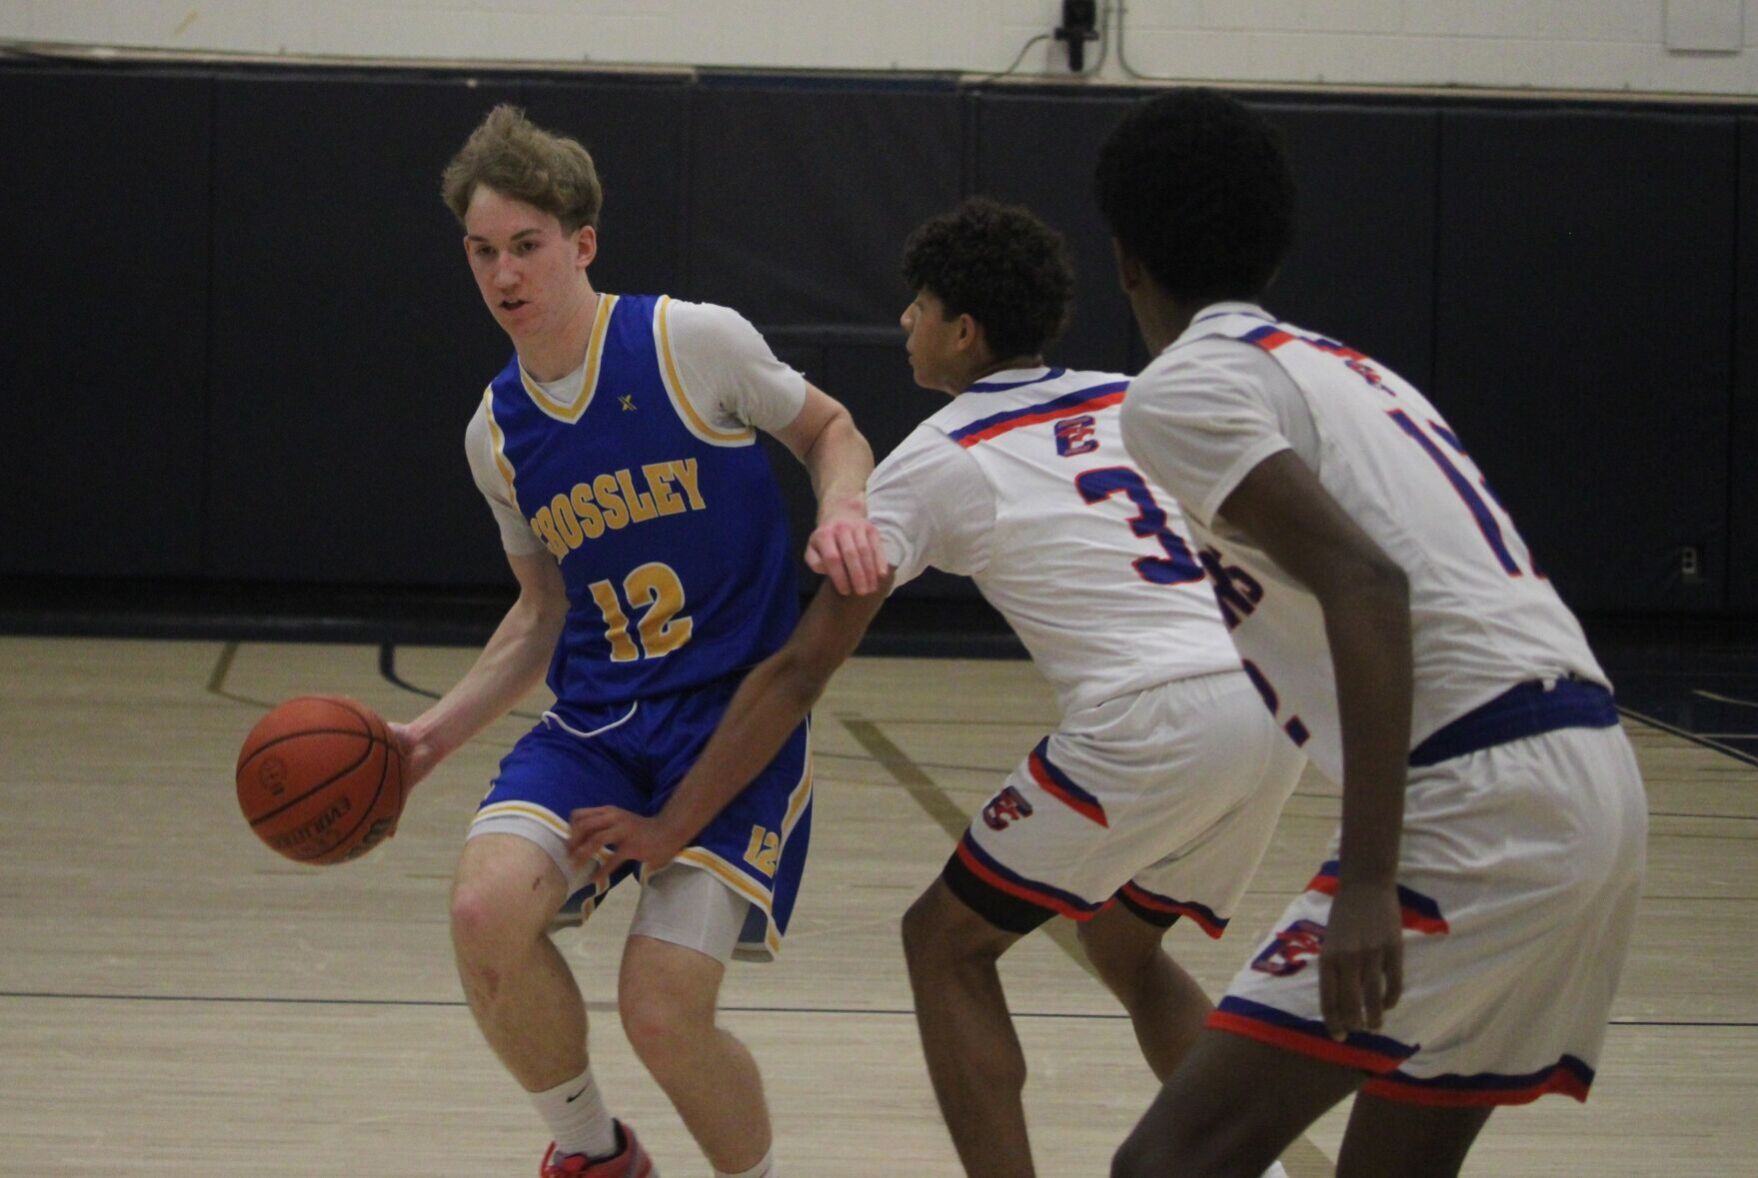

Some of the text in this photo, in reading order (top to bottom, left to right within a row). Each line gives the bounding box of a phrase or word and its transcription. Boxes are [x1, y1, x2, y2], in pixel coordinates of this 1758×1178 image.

[1075, 466, 1205, 585] 3
[588, 562, 693, 662] 12
[743, 824, 780, 879] 12
